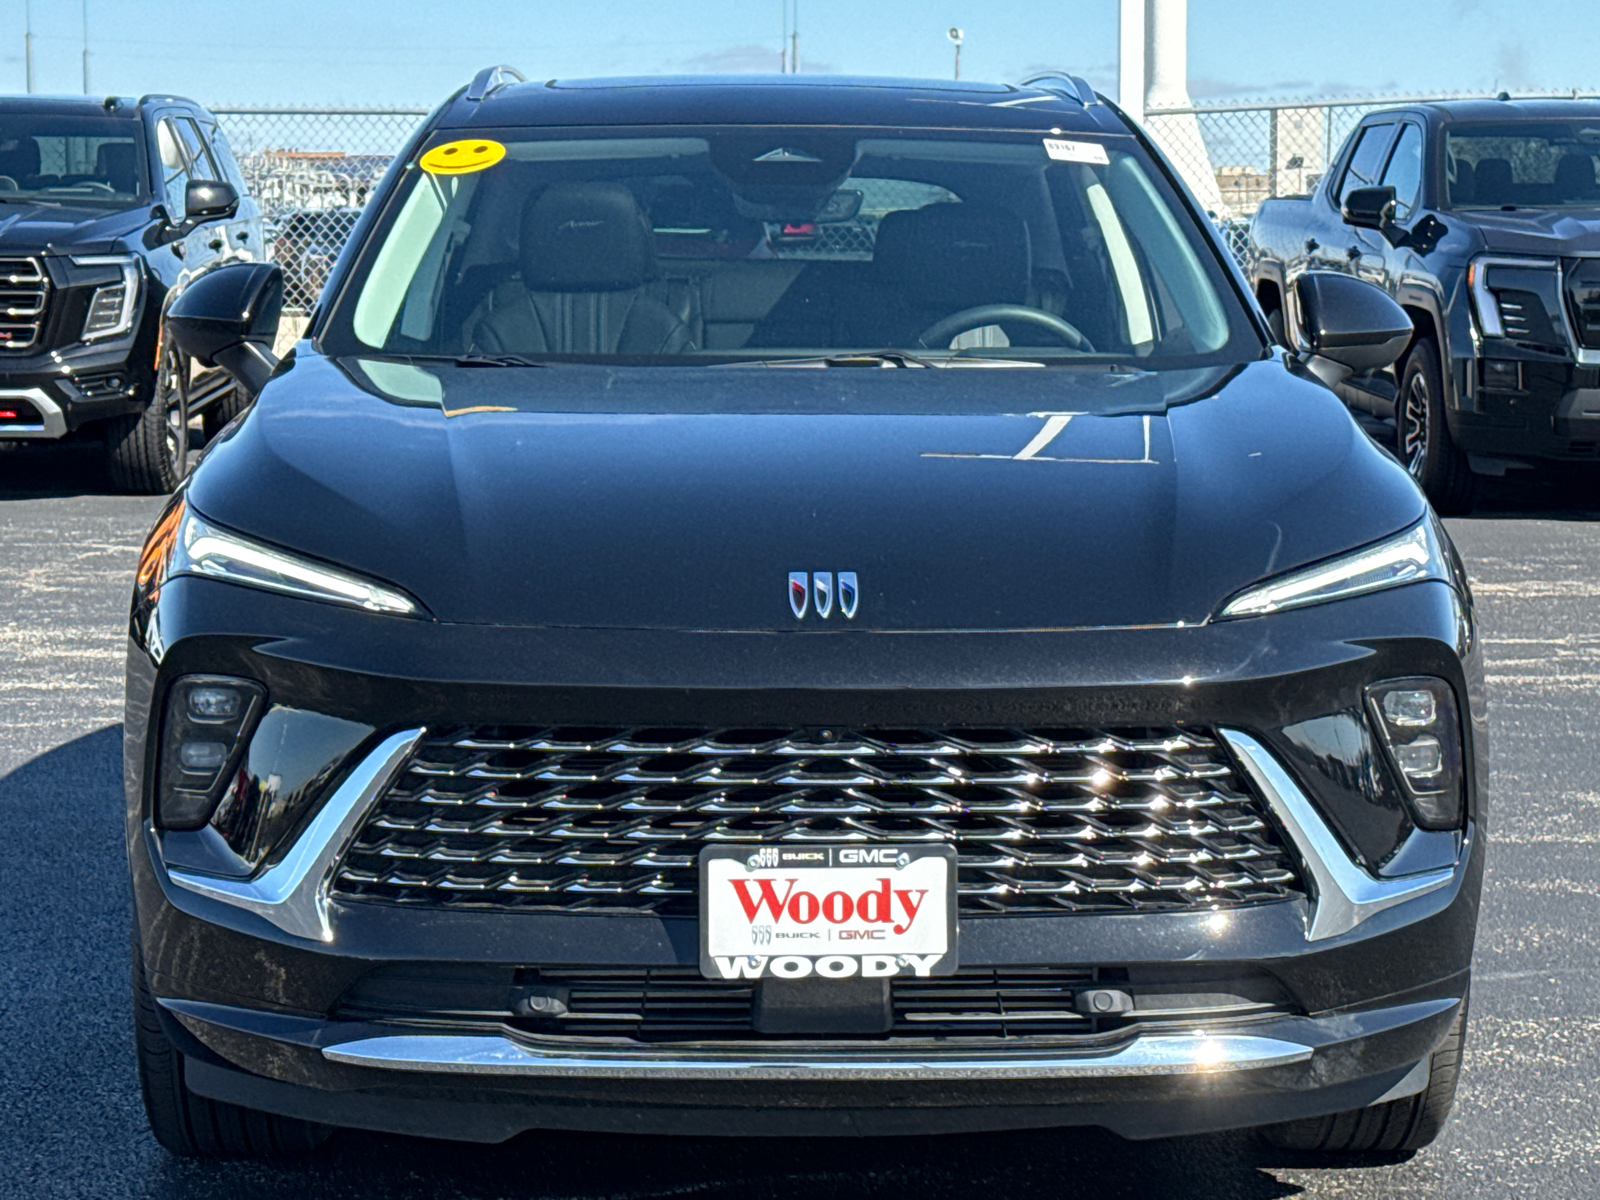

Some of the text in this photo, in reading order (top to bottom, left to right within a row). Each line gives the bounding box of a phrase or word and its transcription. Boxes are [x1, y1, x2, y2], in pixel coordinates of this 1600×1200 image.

[782, 849, 899, 863] BUICK GMC
[727, 878, 929, 935] Woody
[838, 929, 886, 940] GMC
[714, 954, 943, 979] WOODY
